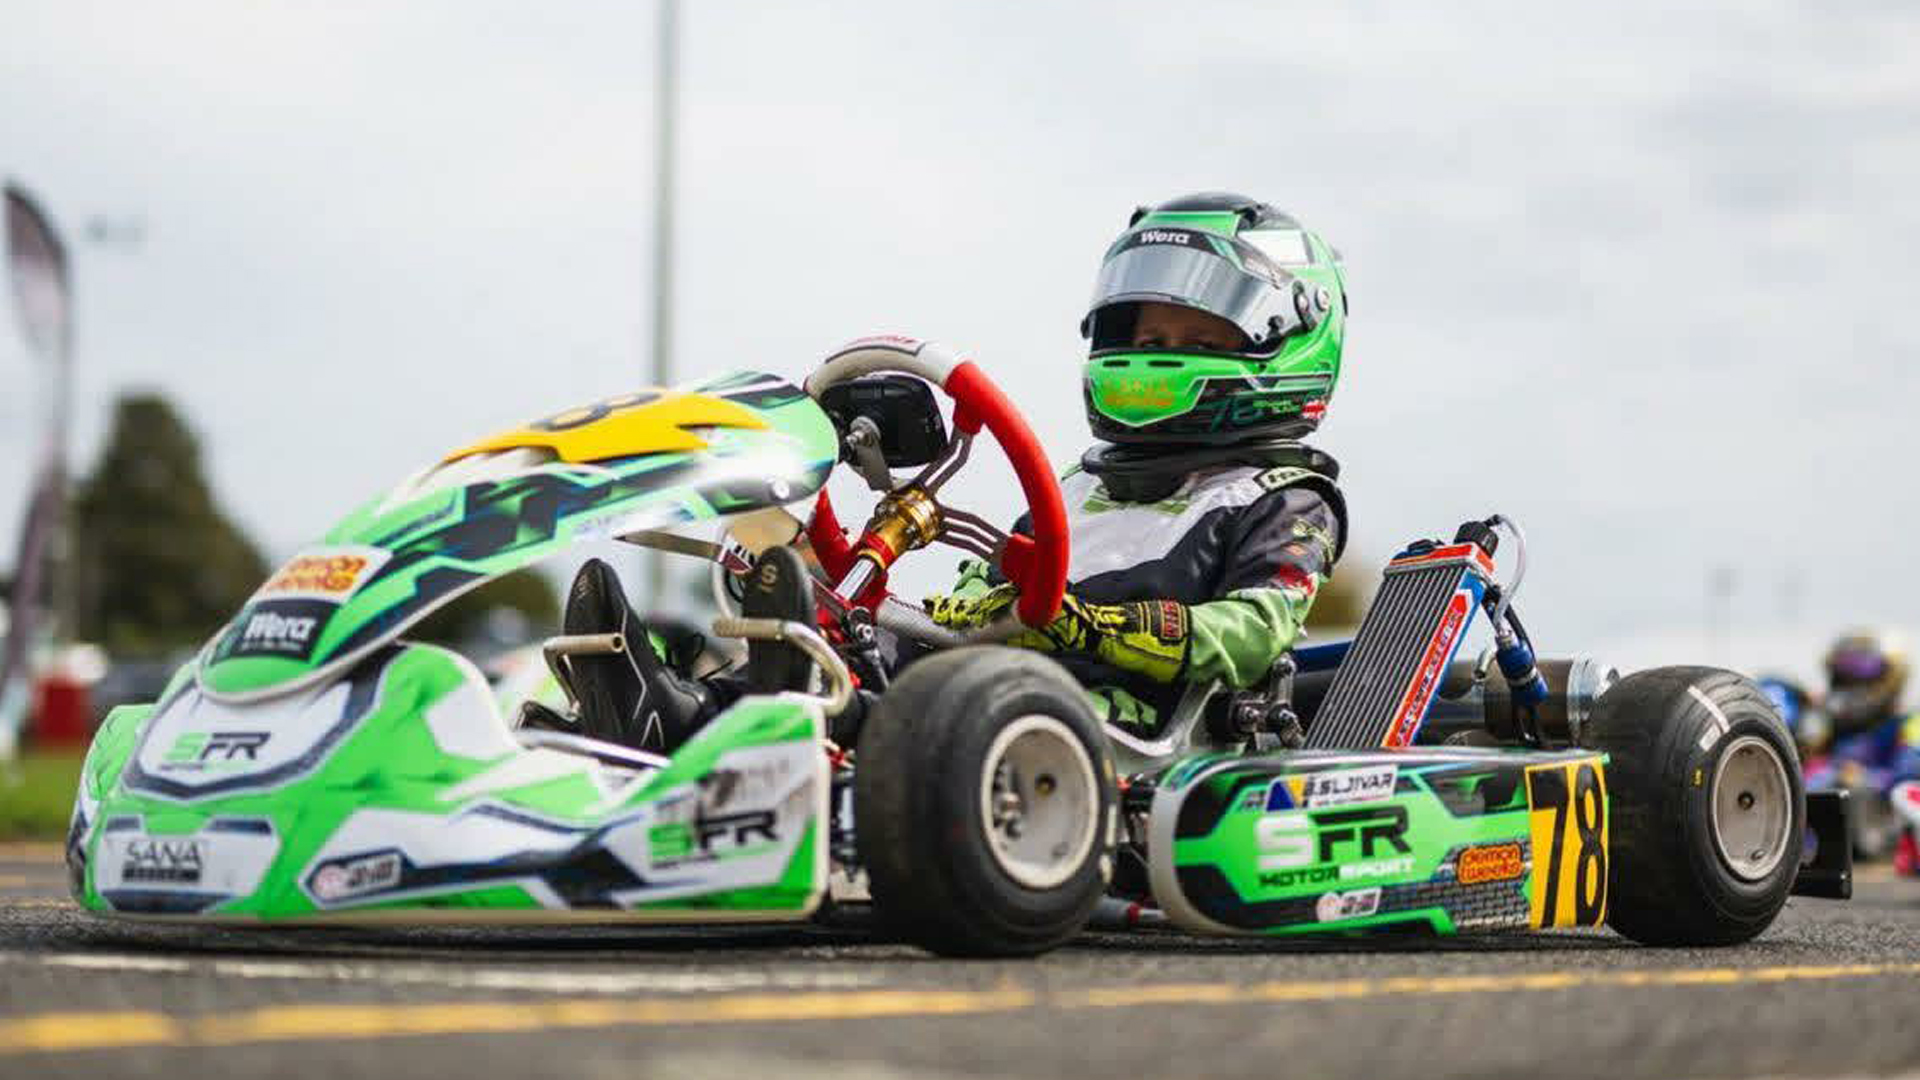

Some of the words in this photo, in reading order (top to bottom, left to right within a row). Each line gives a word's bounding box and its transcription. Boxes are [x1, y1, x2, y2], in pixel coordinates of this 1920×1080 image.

[1140, 230, 1190, 245] Wera
[244, 612, 317, 641] Wera
[160, 732, 272, 760] SFR
[648, 810, 780, 857] SFR
[1255, 805, 1414, 869] SFR
[1532, 762, 1606, 930] 78
[127, 841, 203, 868] SANA
